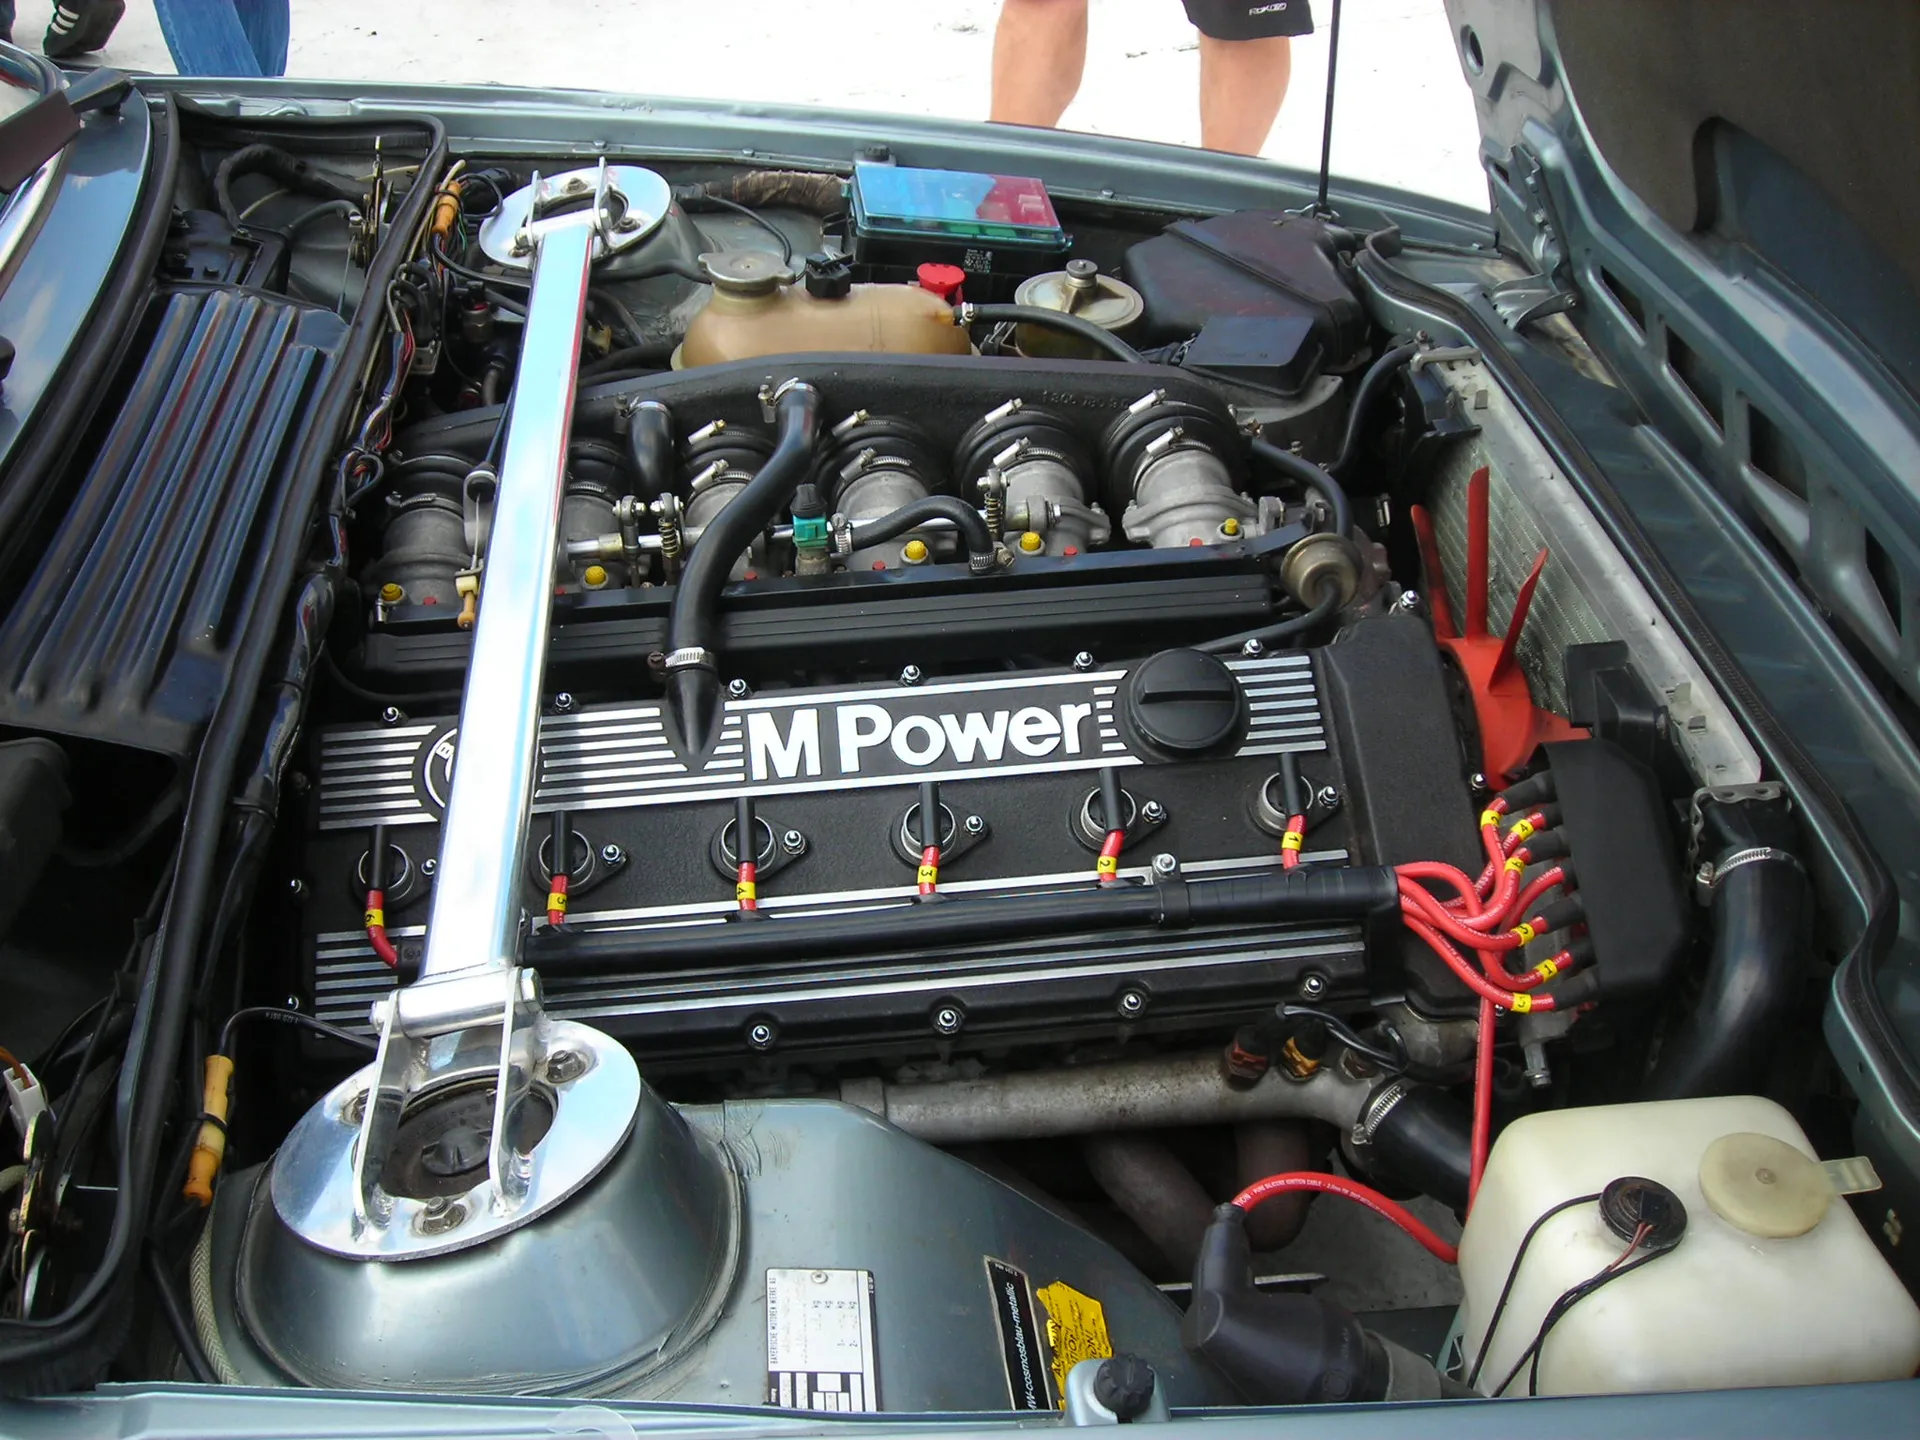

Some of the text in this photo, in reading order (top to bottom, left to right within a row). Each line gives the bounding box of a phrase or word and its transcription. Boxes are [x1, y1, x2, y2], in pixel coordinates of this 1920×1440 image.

[747, 702, 1092, 781] M Power
[1519, 822, 1529, 833] 4
[1099, 859, 1112, 868] 2
[920, 869, 934, 878] 3
[737, 886, 748, 895] 4
[1544, 964, 1554, 976] 1
